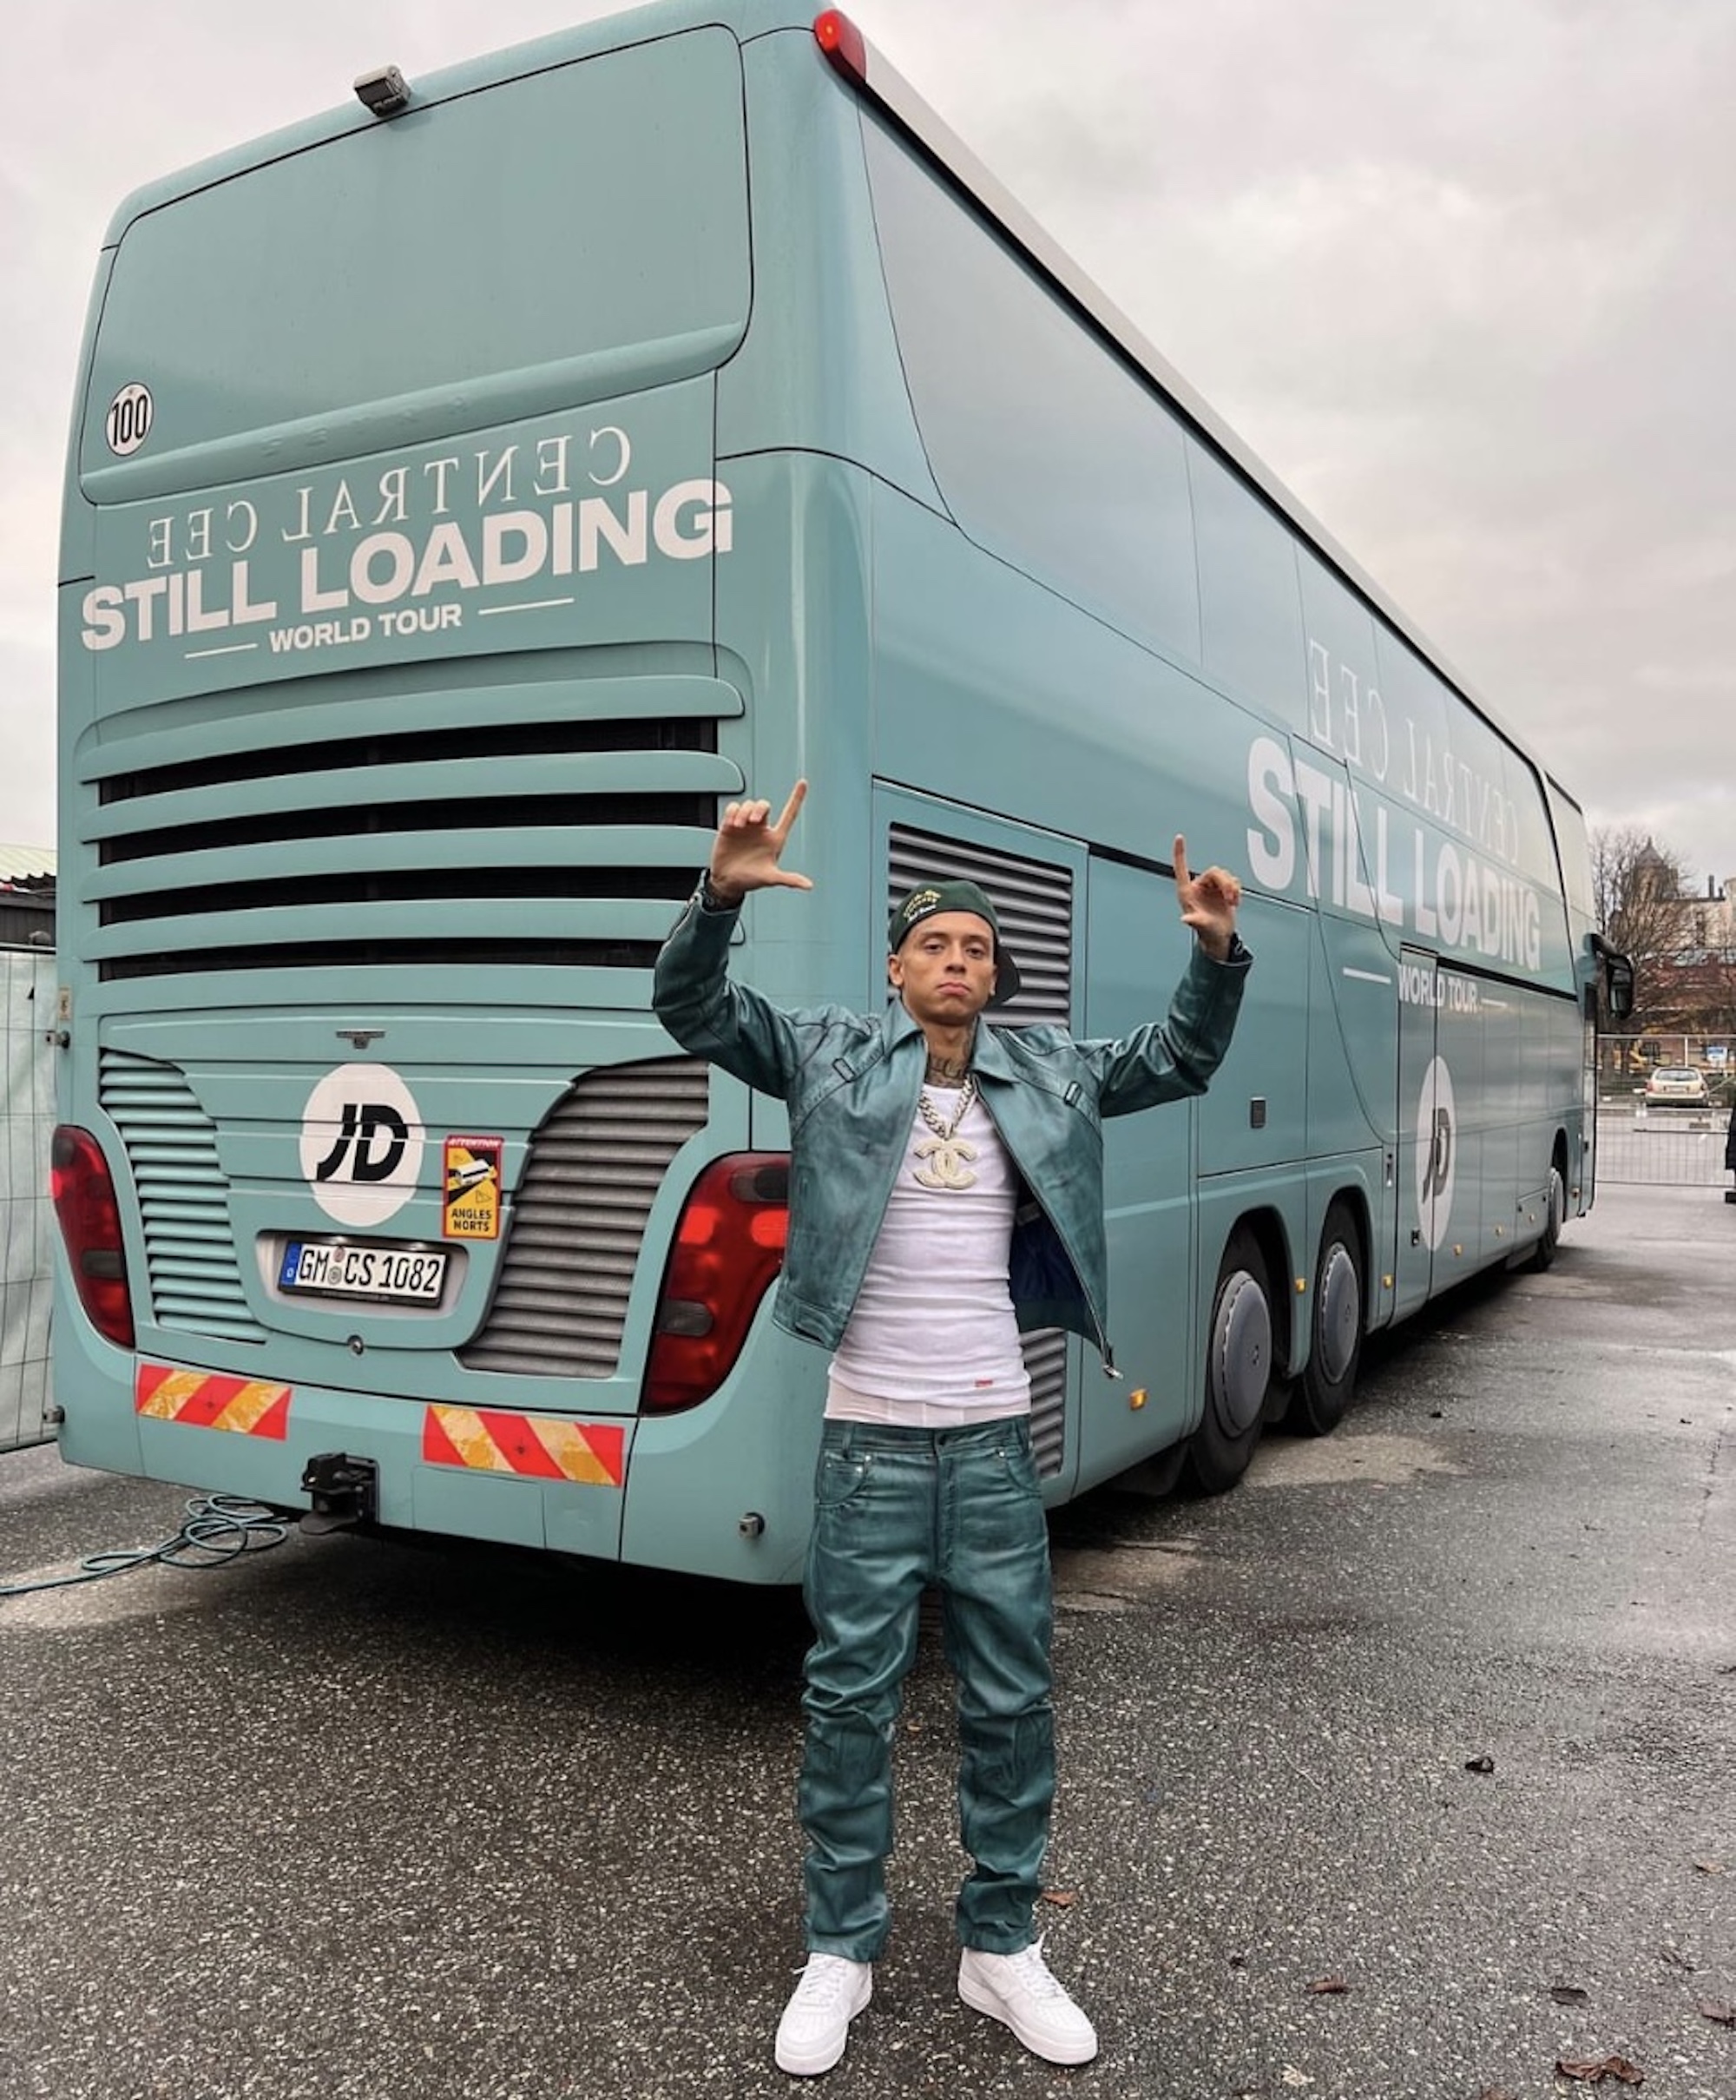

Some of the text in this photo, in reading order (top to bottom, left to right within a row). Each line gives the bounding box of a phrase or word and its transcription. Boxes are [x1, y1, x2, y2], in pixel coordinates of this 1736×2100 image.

[112, 394, 148, 446] 100
[81, 478, 734, 651] STILL LOADING
[269, 603, 463, 655] WORLD TOUR
[1246, 736, 1542, 971] STILL LOADING
[1397, 963, 1478, 1014] WORLD TOUR
[316, 1103, 409, 1181] JD
[1422, 1107, 1450, 1205] JD
[451, 1208, 492, 1220] ANGLES
[299, 1249, 329, 1283] GM
[345, 1253, 376, 1287] CS
[378, 1255, 439, 1292] 1082
